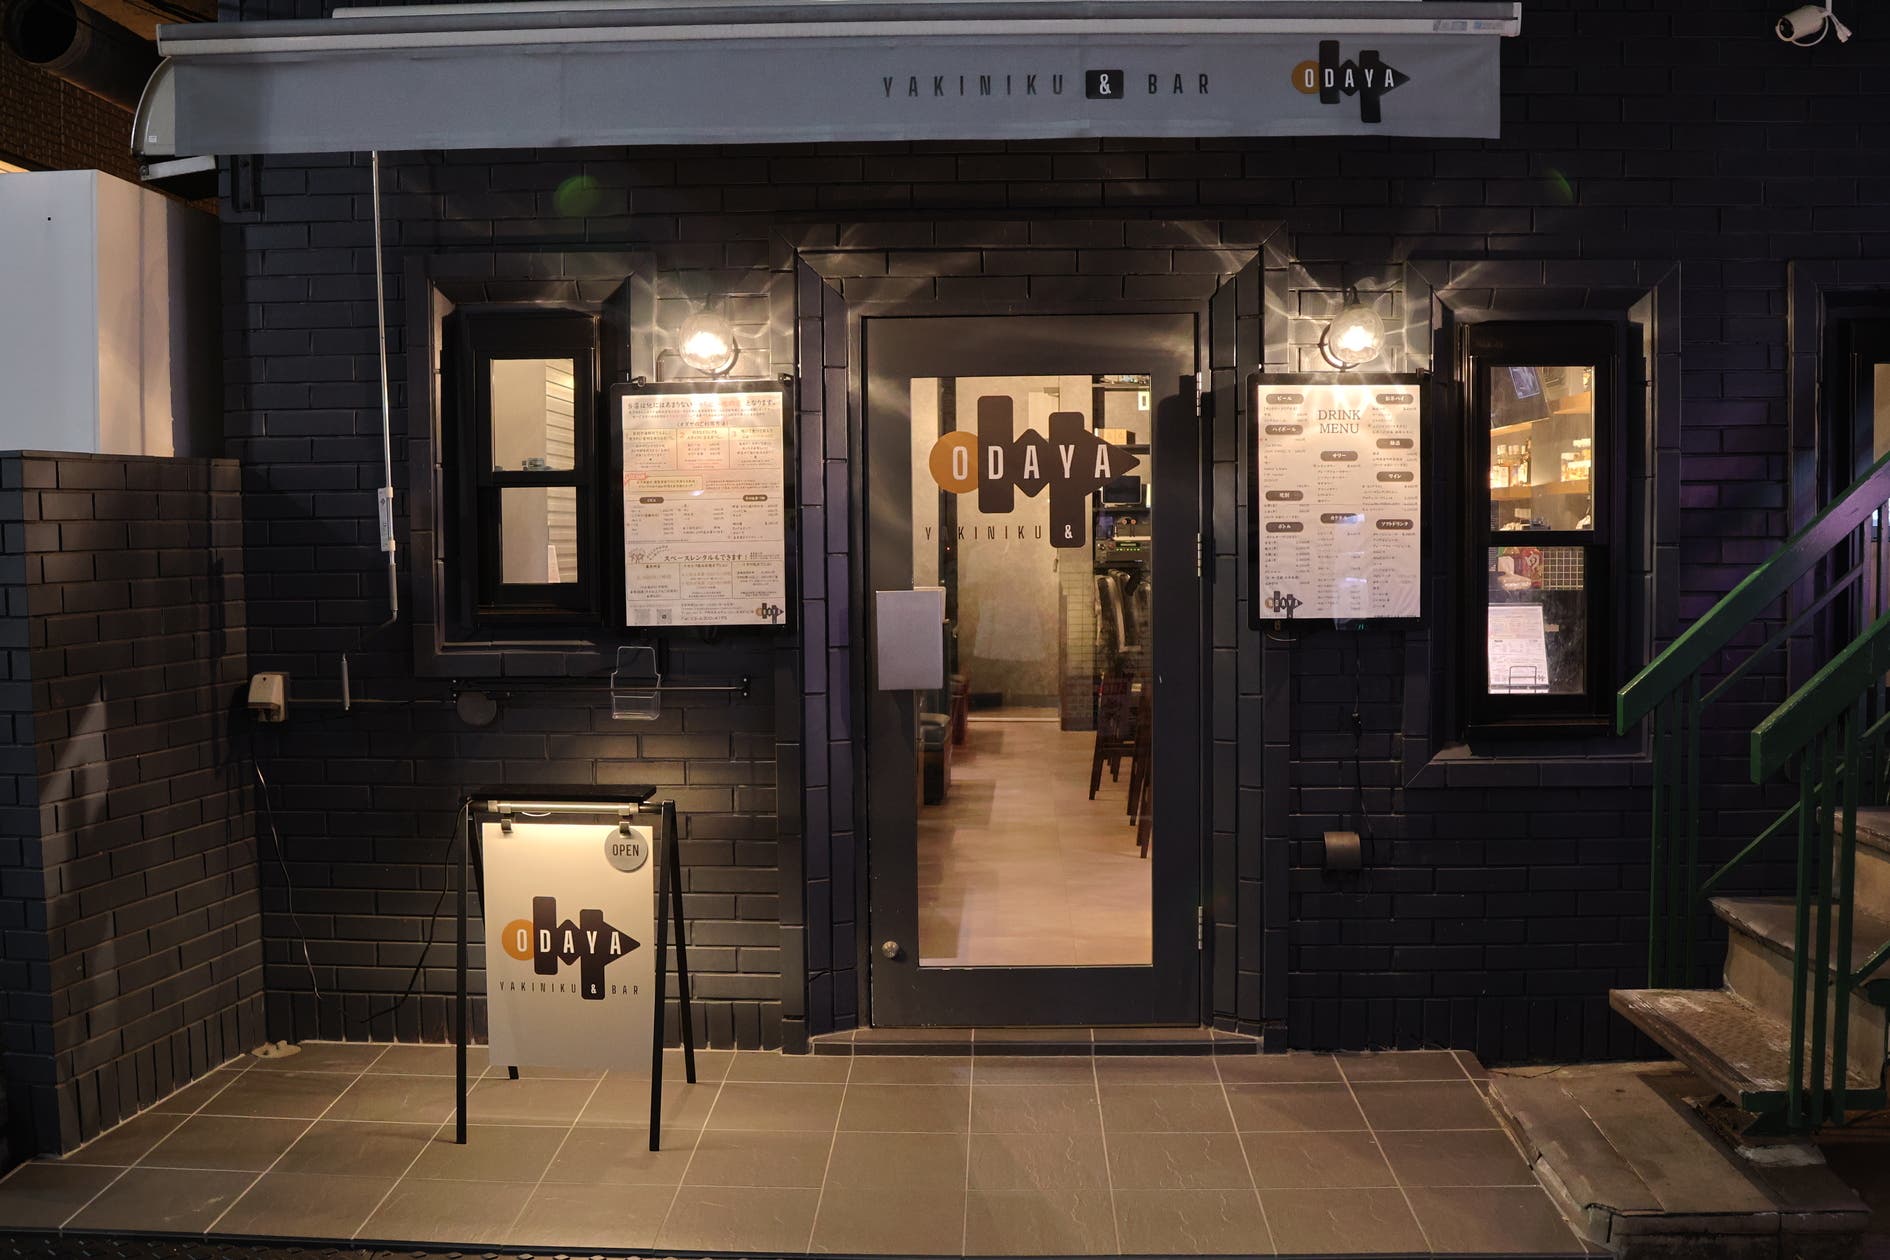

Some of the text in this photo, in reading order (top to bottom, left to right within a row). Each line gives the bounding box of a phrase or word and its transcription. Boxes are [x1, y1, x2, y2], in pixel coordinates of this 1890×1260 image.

[883, 73, 1209, 98] YAKINIKU & BAR
[1304, 67, 1396, 89] ODAYA
[1317, 409, 1361, 421] DRINK
[1319, 423, 1359, 434] MENU
[952, 444, 1111, 480] ODAYA
[1064, 524, 1073, 539] &
[612, 843, 640, 857] OPEN
[516, 929, 622, 956] ODAYA
[499, 981, 639, 995] YAKINIKU & BAR
